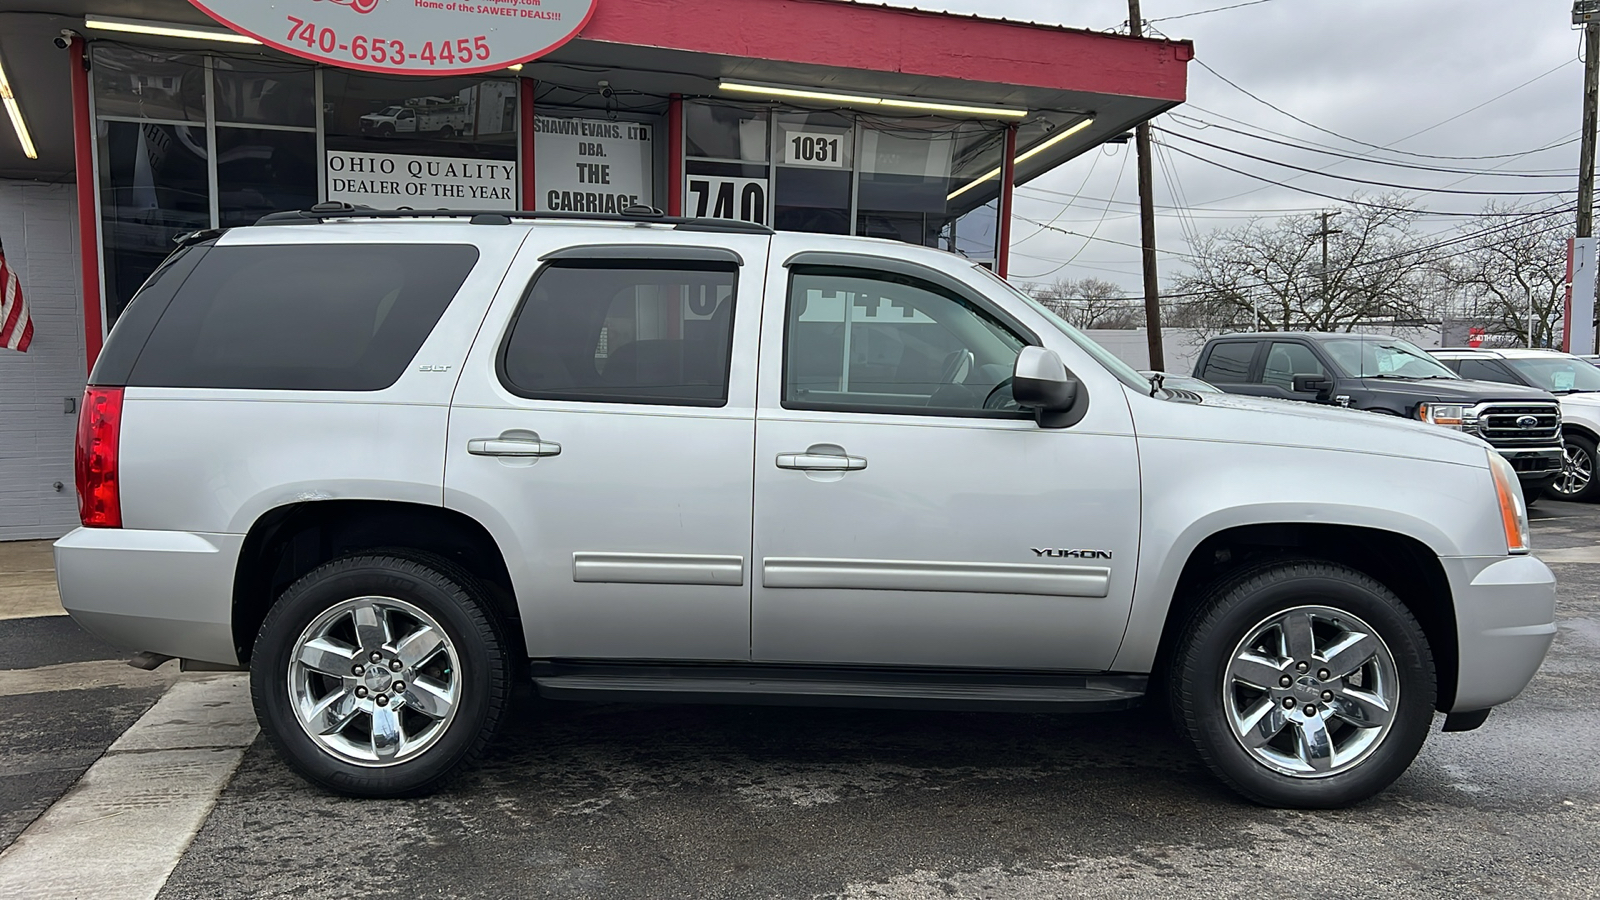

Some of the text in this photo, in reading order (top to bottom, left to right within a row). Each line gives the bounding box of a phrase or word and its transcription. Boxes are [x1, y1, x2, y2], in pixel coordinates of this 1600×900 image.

[415, 0, 443, 9] Home
[459, 4, 474, 12] the
[477, 5, 518, 17] SAWEET
[520, 9, 561, 20] DEALS!!!
[286, 15, 491, 65] 740-653-4455
[533, 118, 650, 141] SHAWN EVANS. LTD.
[578, 142, 607, 157] DBA.
[792, 136, 838, 162] 1031
[330, 156, 514, 181] OHIO QUALITY
[576, 163, 610, 185] THE
[333, 178, 512, 200] DEALER OF THE YEAR
[690, 180, 765, 224] 740
[1030, 547, 1112, 560] YUKON
